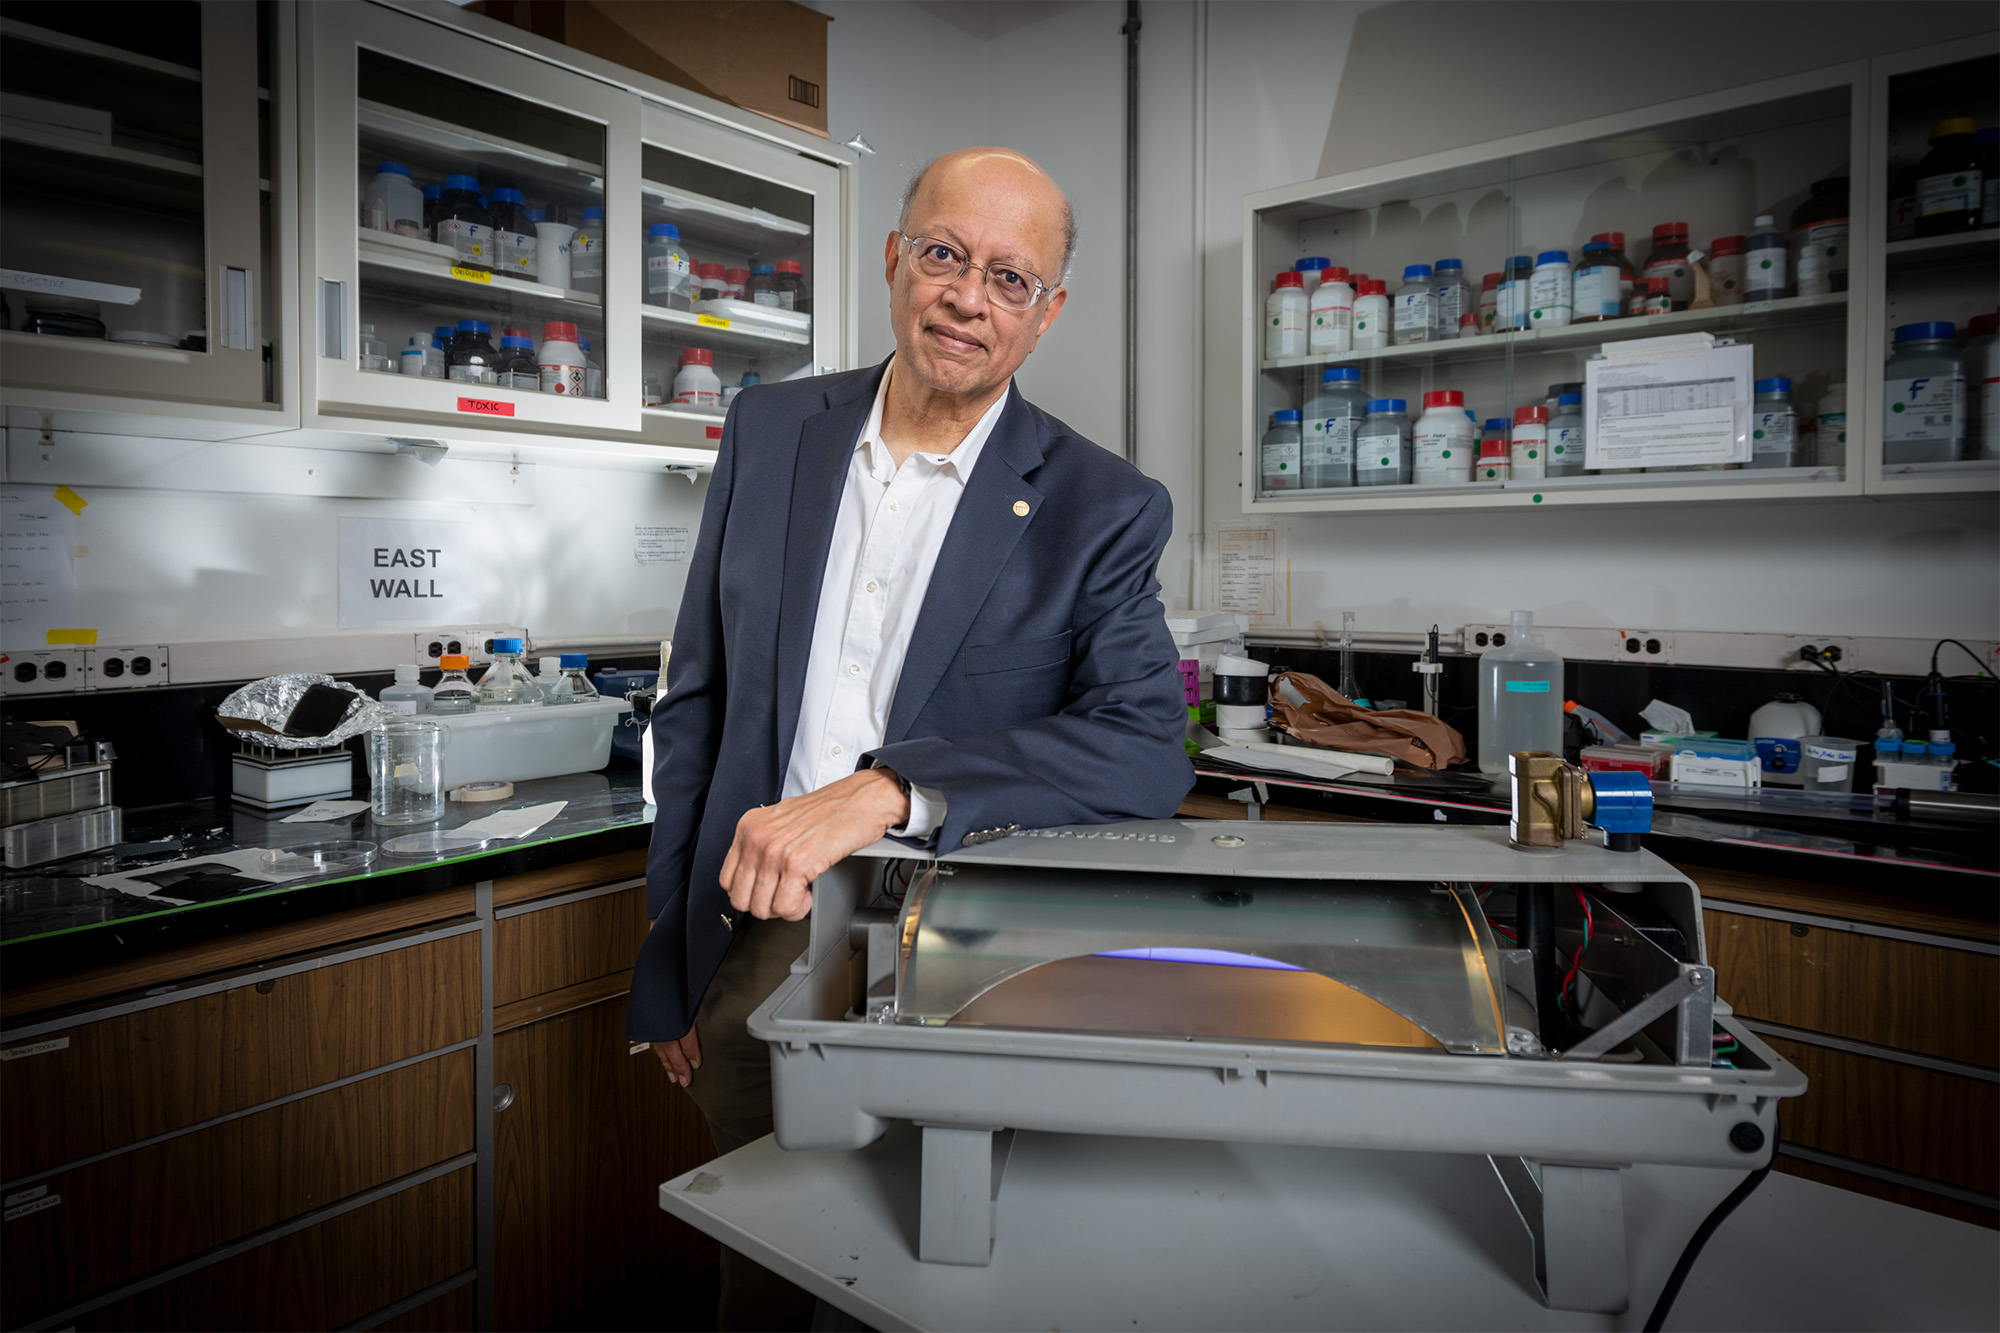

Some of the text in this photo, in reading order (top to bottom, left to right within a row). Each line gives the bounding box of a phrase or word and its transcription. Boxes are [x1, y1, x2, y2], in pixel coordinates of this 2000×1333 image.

[454, 267, 485, 280] OXIDIZER
[467, 400, 500, 411] TOXIC
[374, 548, 441, 568] EAST
[370, 579, 443, 598] WALL
[10, 1042, 57, 1056] BENCH TOOLS
